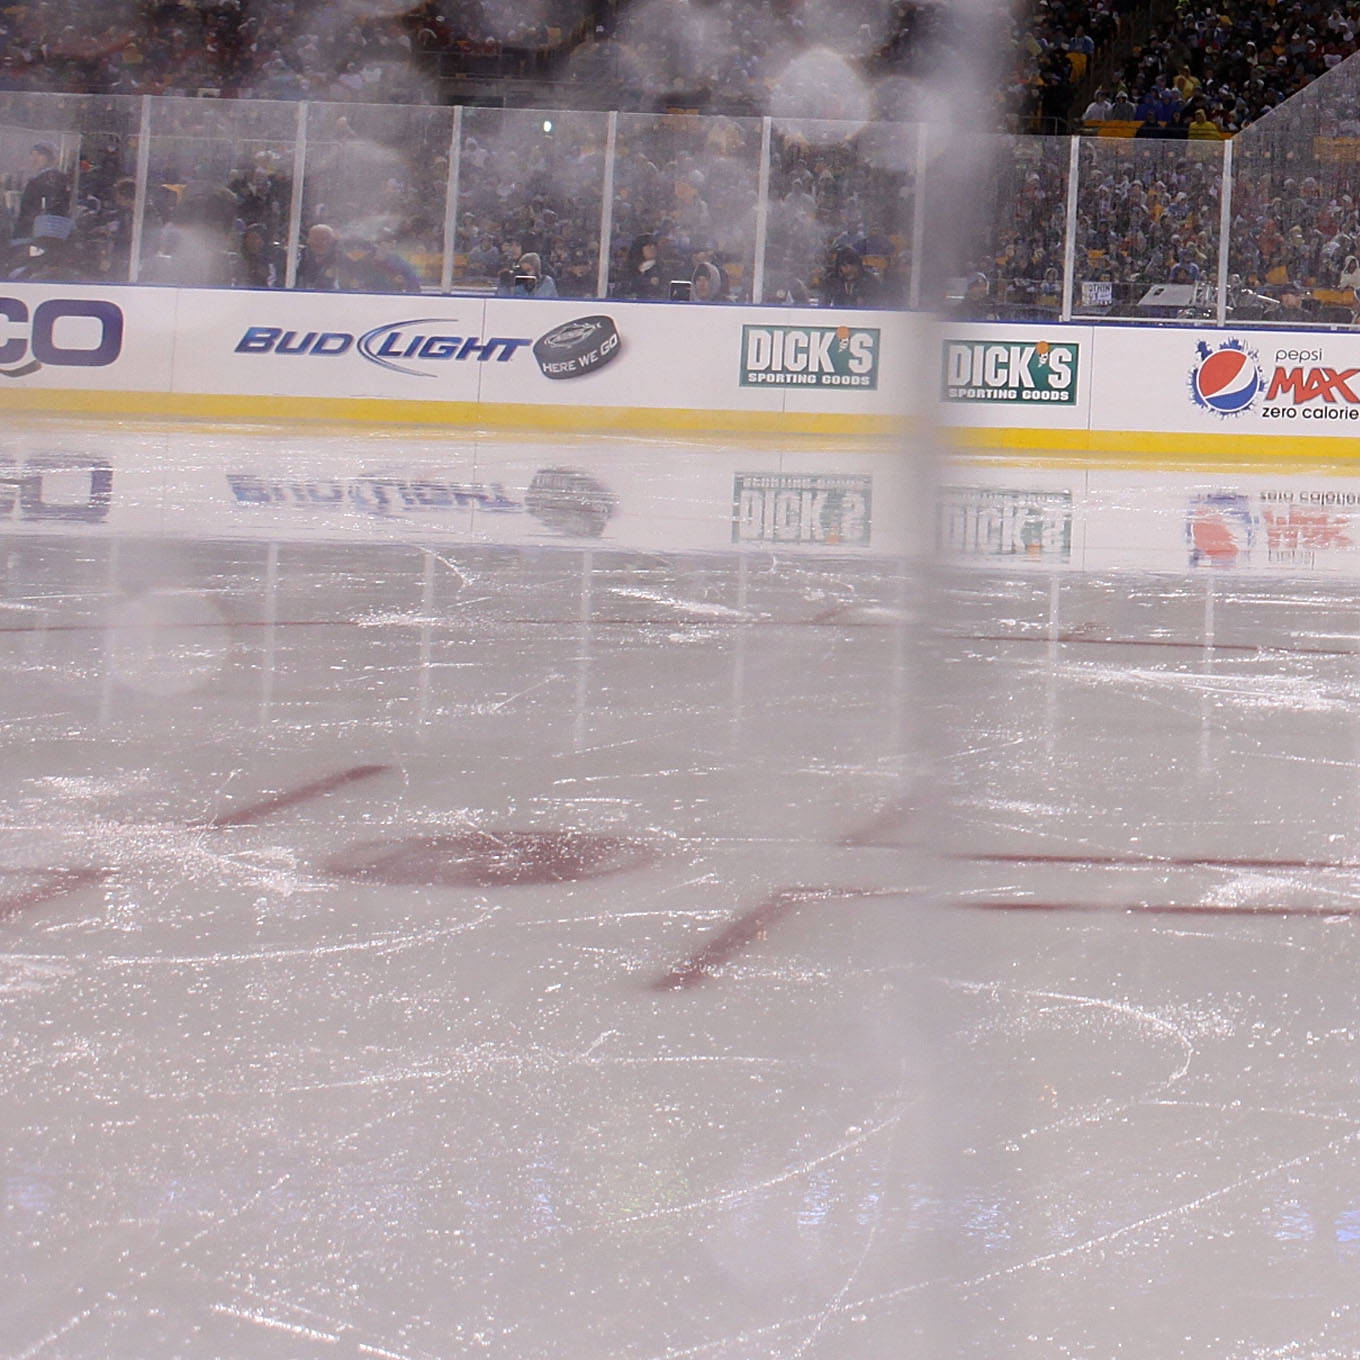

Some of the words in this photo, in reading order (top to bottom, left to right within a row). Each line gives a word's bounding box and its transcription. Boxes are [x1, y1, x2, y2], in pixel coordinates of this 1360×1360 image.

[235, 326, 354, 356] BUD
[375, 331, 533, 362] LIGHT
[542, 359, 577, 372] HERE
[578, 350, 599, 368] WE
[600, 333, 618, 356] GO
[746, 327, 873, 374] DICK'S
[1275, 348, 1323, 363] pepsi
[747, 373, 817, 384] SPORTING
[821, 375, 871, 385] GOODS
[947, 344, 1073, 389] DICK'S
[948, 388, 1017, 400] SPORTING
[1022, 390, 1070, 401] GOODS
[1262, 407, 1297, 419] zero
